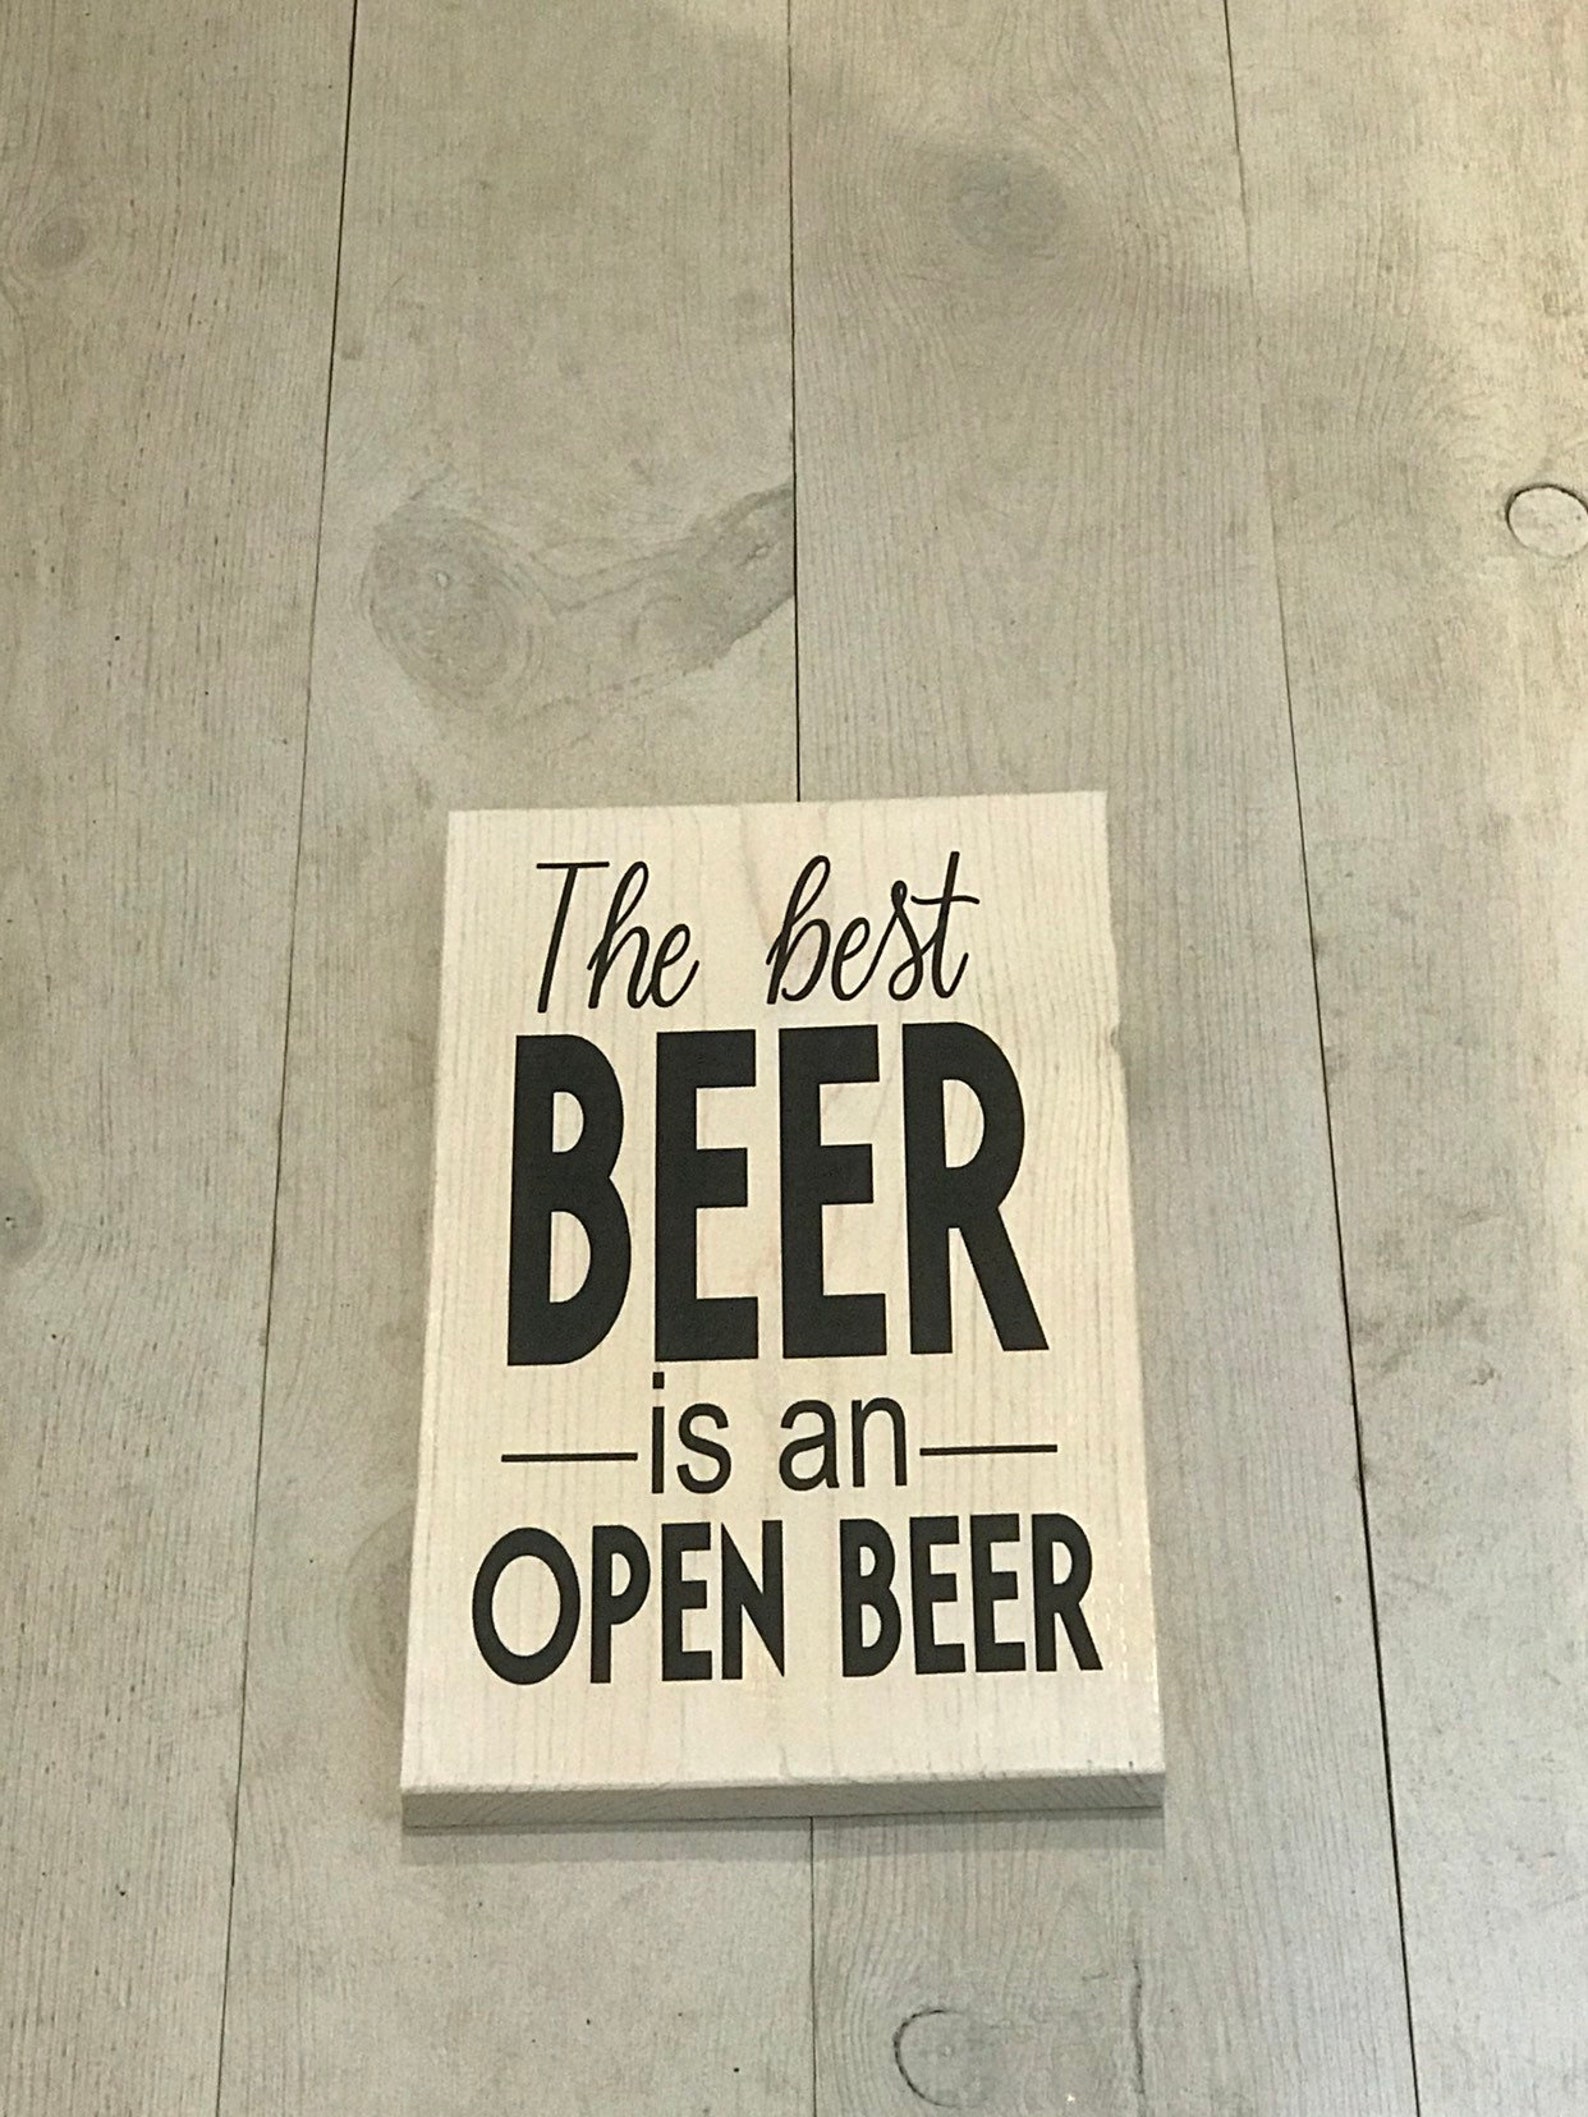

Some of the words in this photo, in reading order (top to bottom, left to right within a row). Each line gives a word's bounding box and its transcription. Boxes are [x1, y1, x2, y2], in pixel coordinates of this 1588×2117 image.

[536, 861, 700, 1014] The
[765, 851, 980, 1005] best
[507, 1021, 1050, 1367] BEER
[651, 1371, 732, 1494] is
[778, 1397, 908, 1492] an
[471, 1519, 786, 1686] OPEN
[839, 1513, 1103, 1678] BEER
